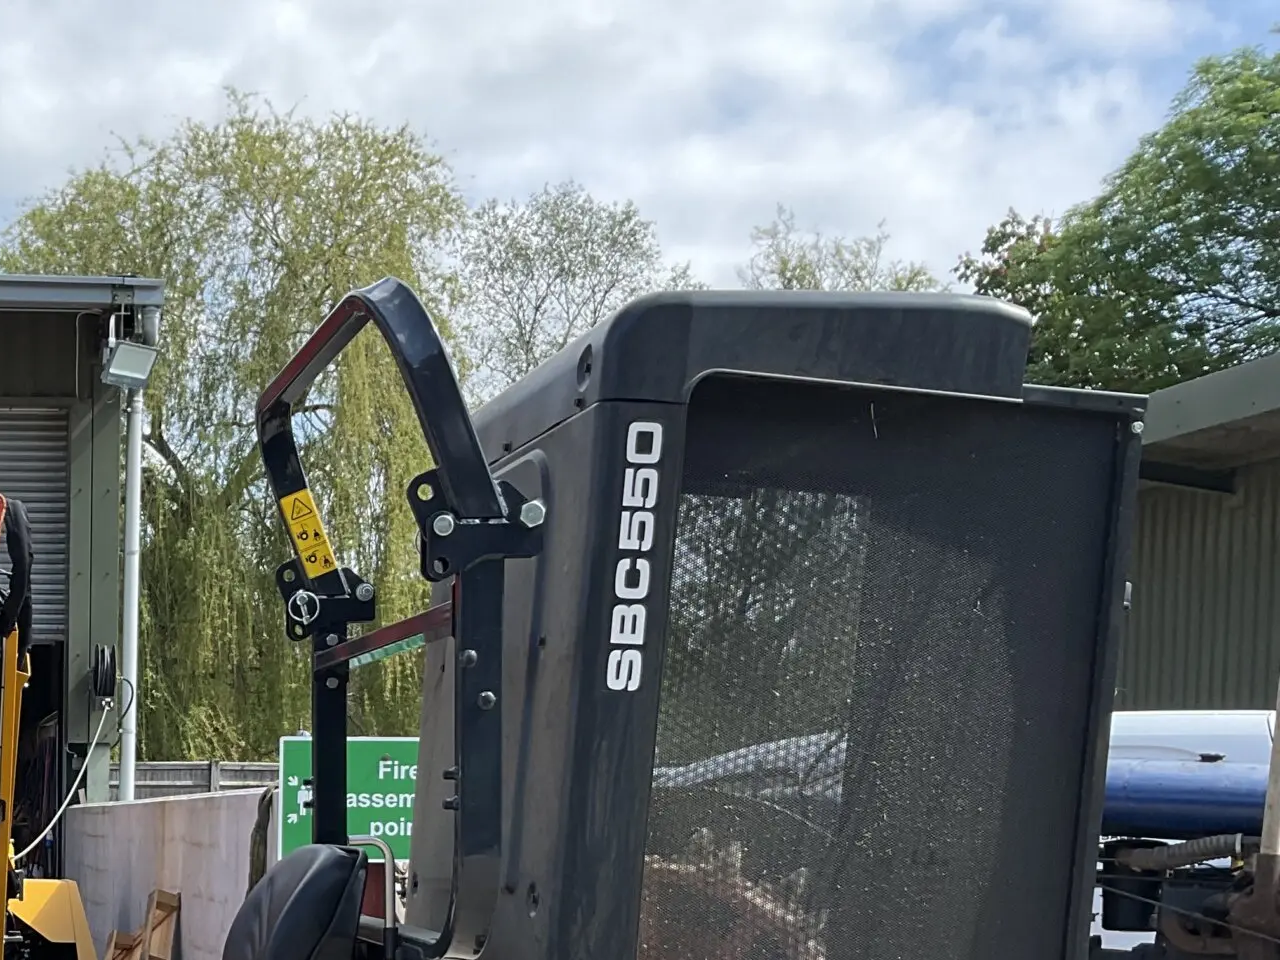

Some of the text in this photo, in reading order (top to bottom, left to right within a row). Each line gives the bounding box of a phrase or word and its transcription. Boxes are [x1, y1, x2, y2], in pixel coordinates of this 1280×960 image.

[606, 421, 663, 692] SBC550
[378, 760, 418, 780] Fire
[347, 792, 416, 808] assem
